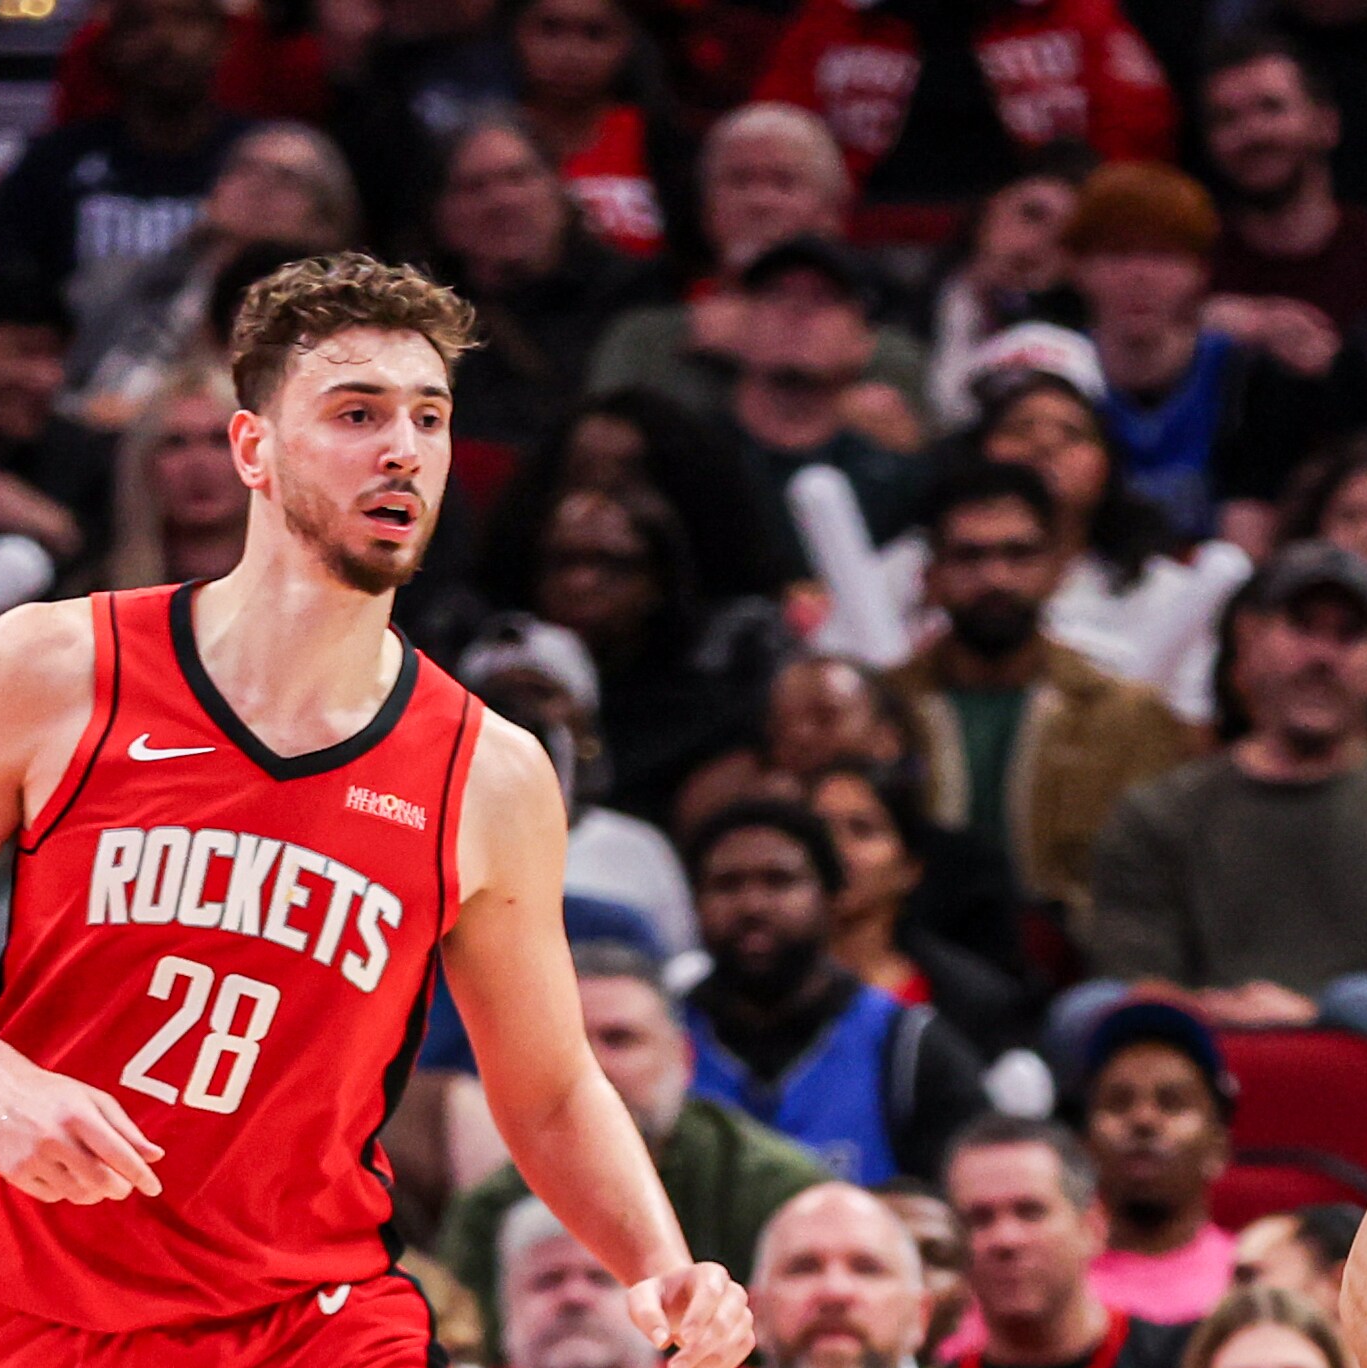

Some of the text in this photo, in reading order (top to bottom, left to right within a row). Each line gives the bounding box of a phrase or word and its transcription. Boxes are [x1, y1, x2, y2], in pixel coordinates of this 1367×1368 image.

[345, 797, 427, 830] HERMANN
[347, 785, 425, 820] MEMORIAL
[86, 826, 403, 993] ROCKETS
[119, 955, 281, 1115] 28
